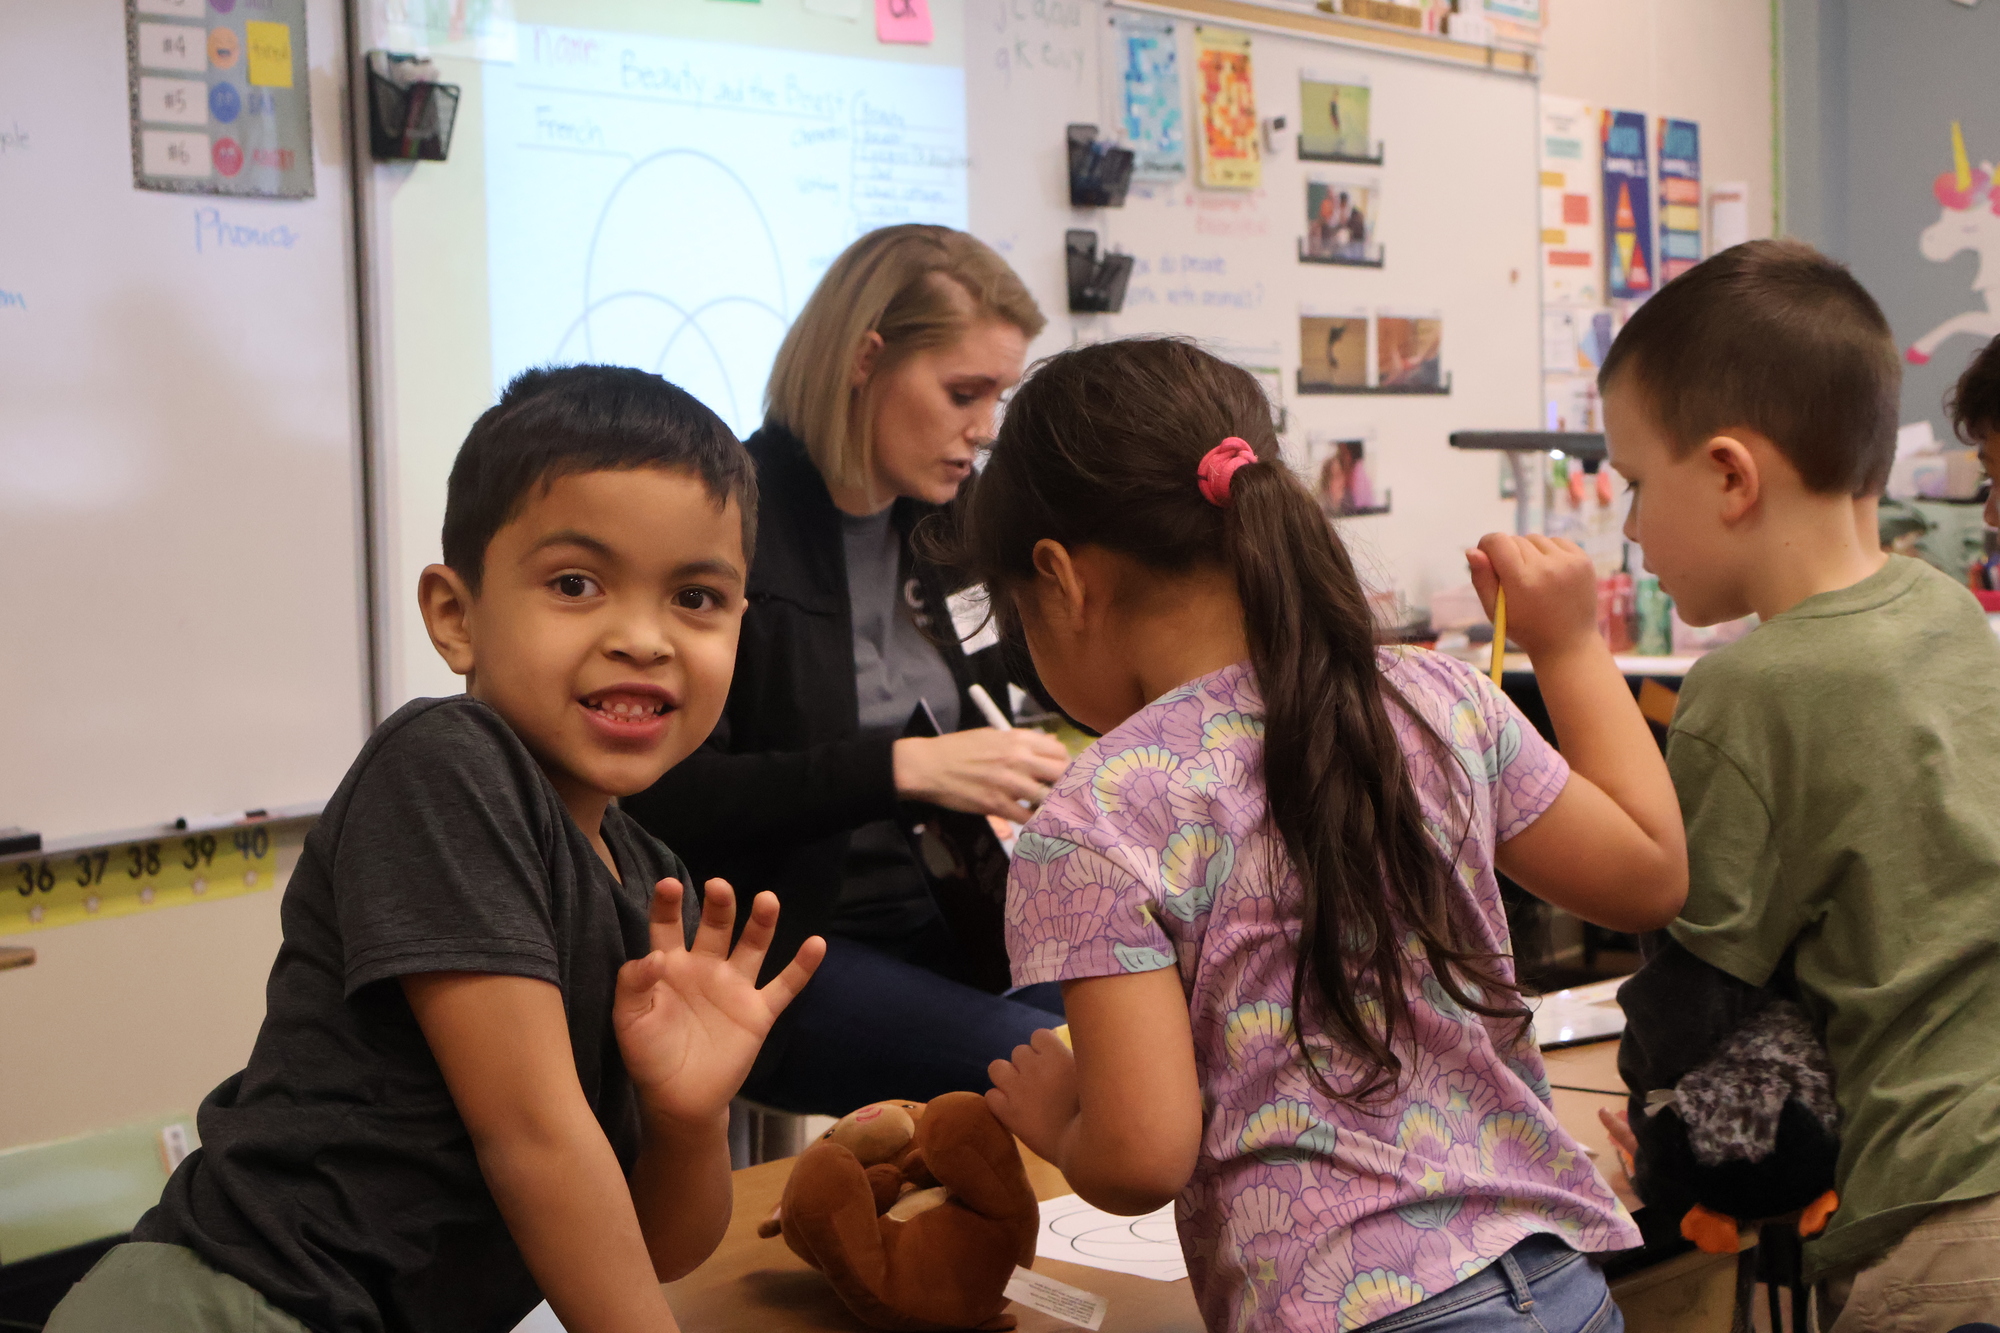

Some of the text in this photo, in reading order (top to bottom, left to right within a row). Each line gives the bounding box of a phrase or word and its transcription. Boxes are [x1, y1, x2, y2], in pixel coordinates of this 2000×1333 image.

[162, 34, 186, 58] #4
[620, 48, 708, 112] Beauty
[748, 74, 777, 106] the
[784, 73, 845, 116] Beast
[163, 92, 187, 115] #5
[534, 105, 606, 147] French
[167, 144, 191, 167] #6
[193, 206, 300, 254] Phonics
[16, 826, 269, 897] 36 37 38 39 40
